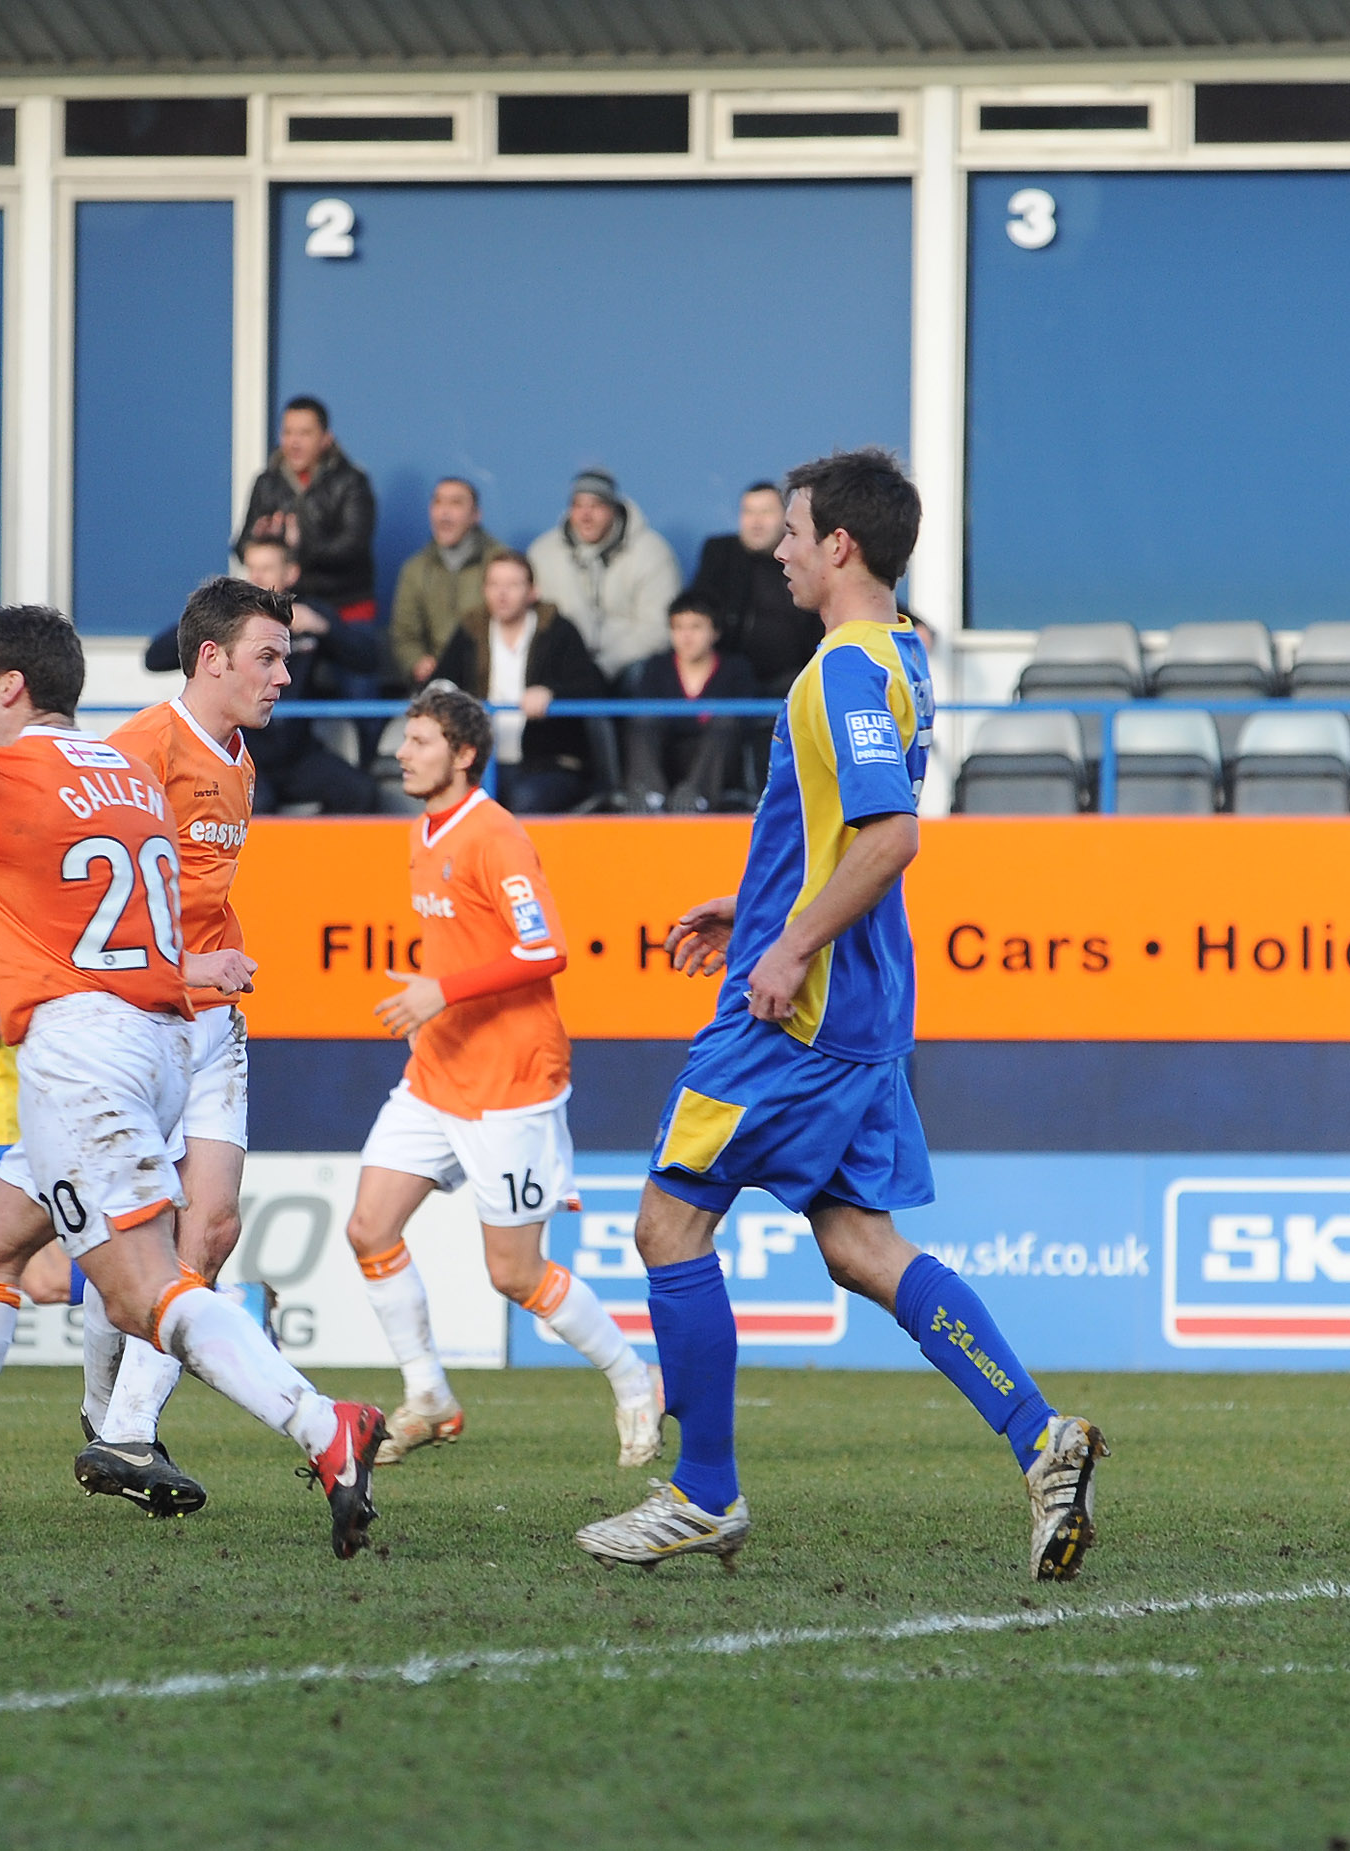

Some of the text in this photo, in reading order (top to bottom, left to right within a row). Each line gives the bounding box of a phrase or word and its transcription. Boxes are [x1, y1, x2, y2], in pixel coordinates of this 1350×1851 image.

[305, 198, 355, 257] 2
[1006, 188, 1057, 249] 3
[851, 714, 893, 731] BLUE
[853, 729, 883, 747] SQ
[58, 772, 165, 820] GALLEN
[61, 834, 184, 970] 20
[947, 924, 1111, 972] Cars
[1196, 923, 1350, 972] Holi
[502, 1167, 544, 1213] 16
[573, 1211, 814, 1280] SF
[1202, 1214, 1350, 1283] SK
